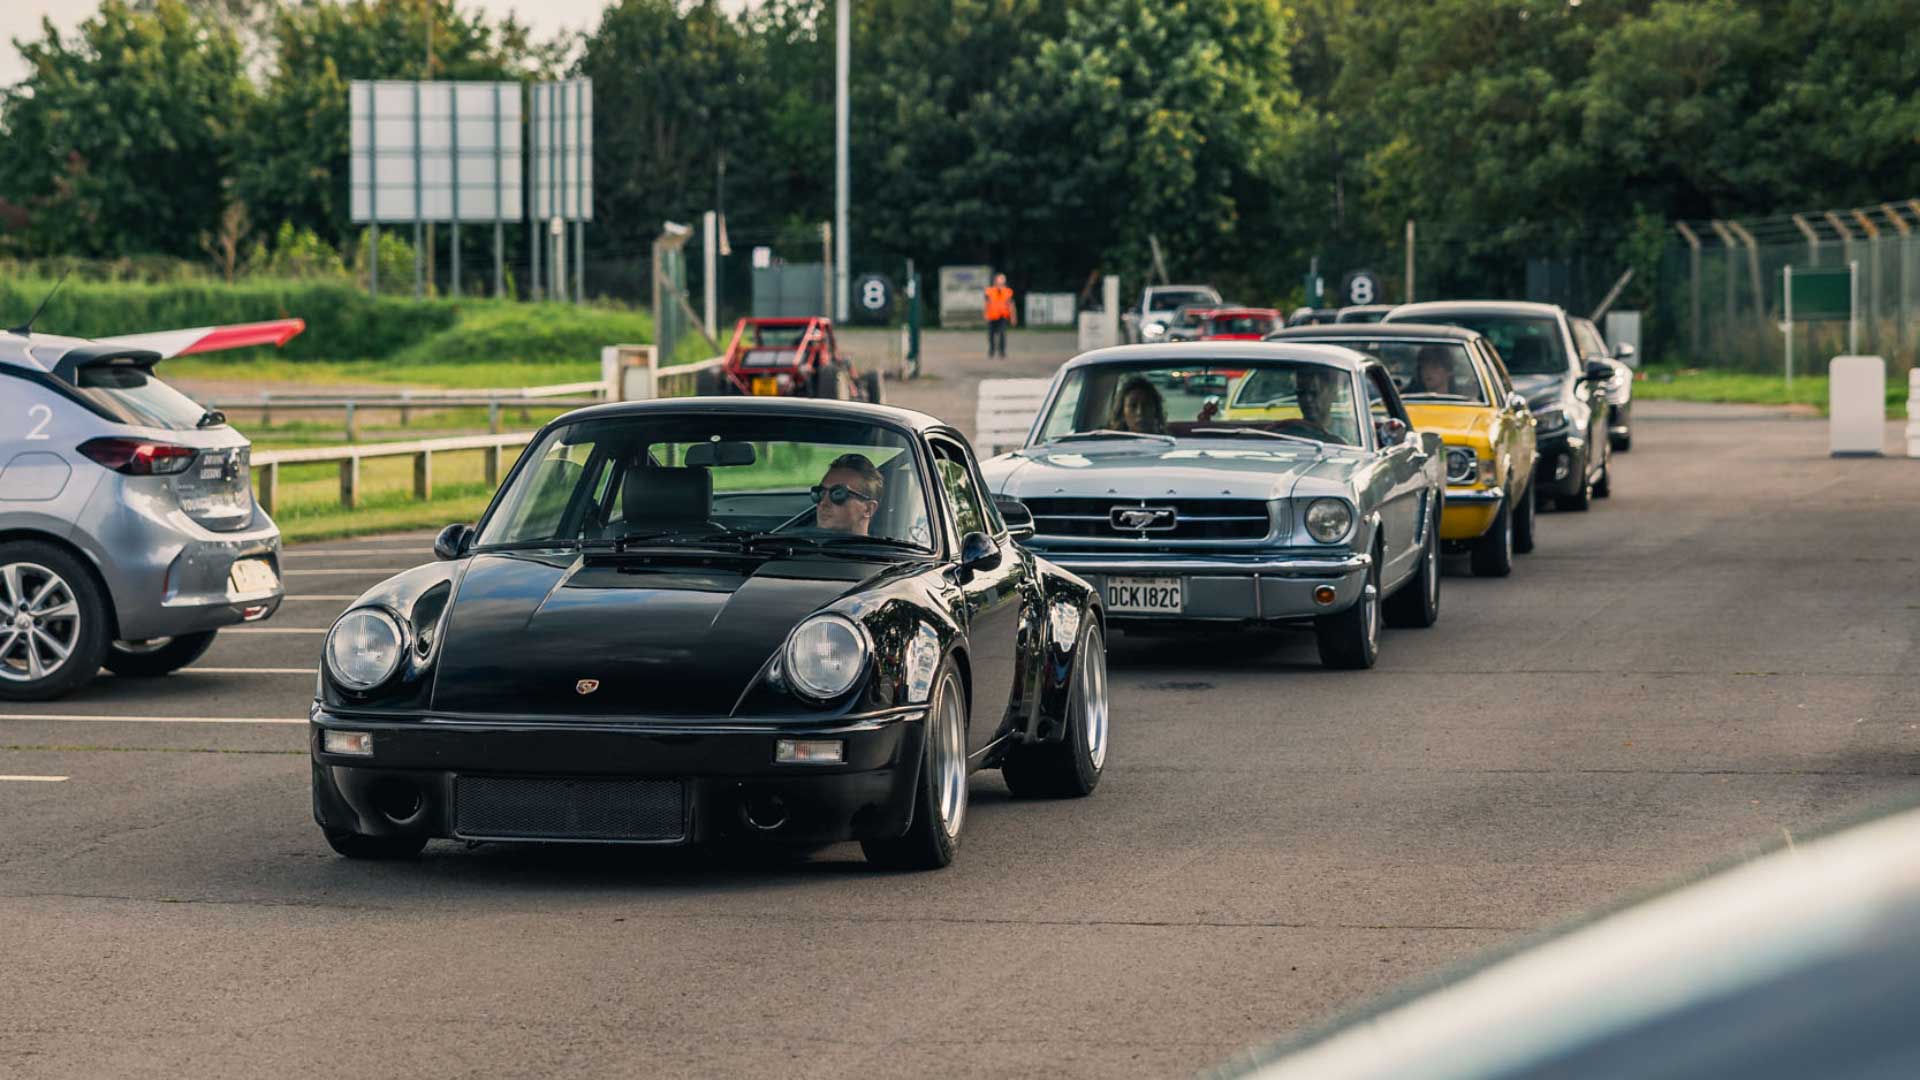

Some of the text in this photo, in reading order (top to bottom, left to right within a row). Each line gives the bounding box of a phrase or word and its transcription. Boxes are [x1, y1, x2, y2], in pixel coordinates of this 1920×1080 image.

[863, 280, 885, 309] 8
[1351, 276, 1374, 305] 8
[25, 403, 52, 439] 2
[1109, 586, 1180, 608] DCK182C
